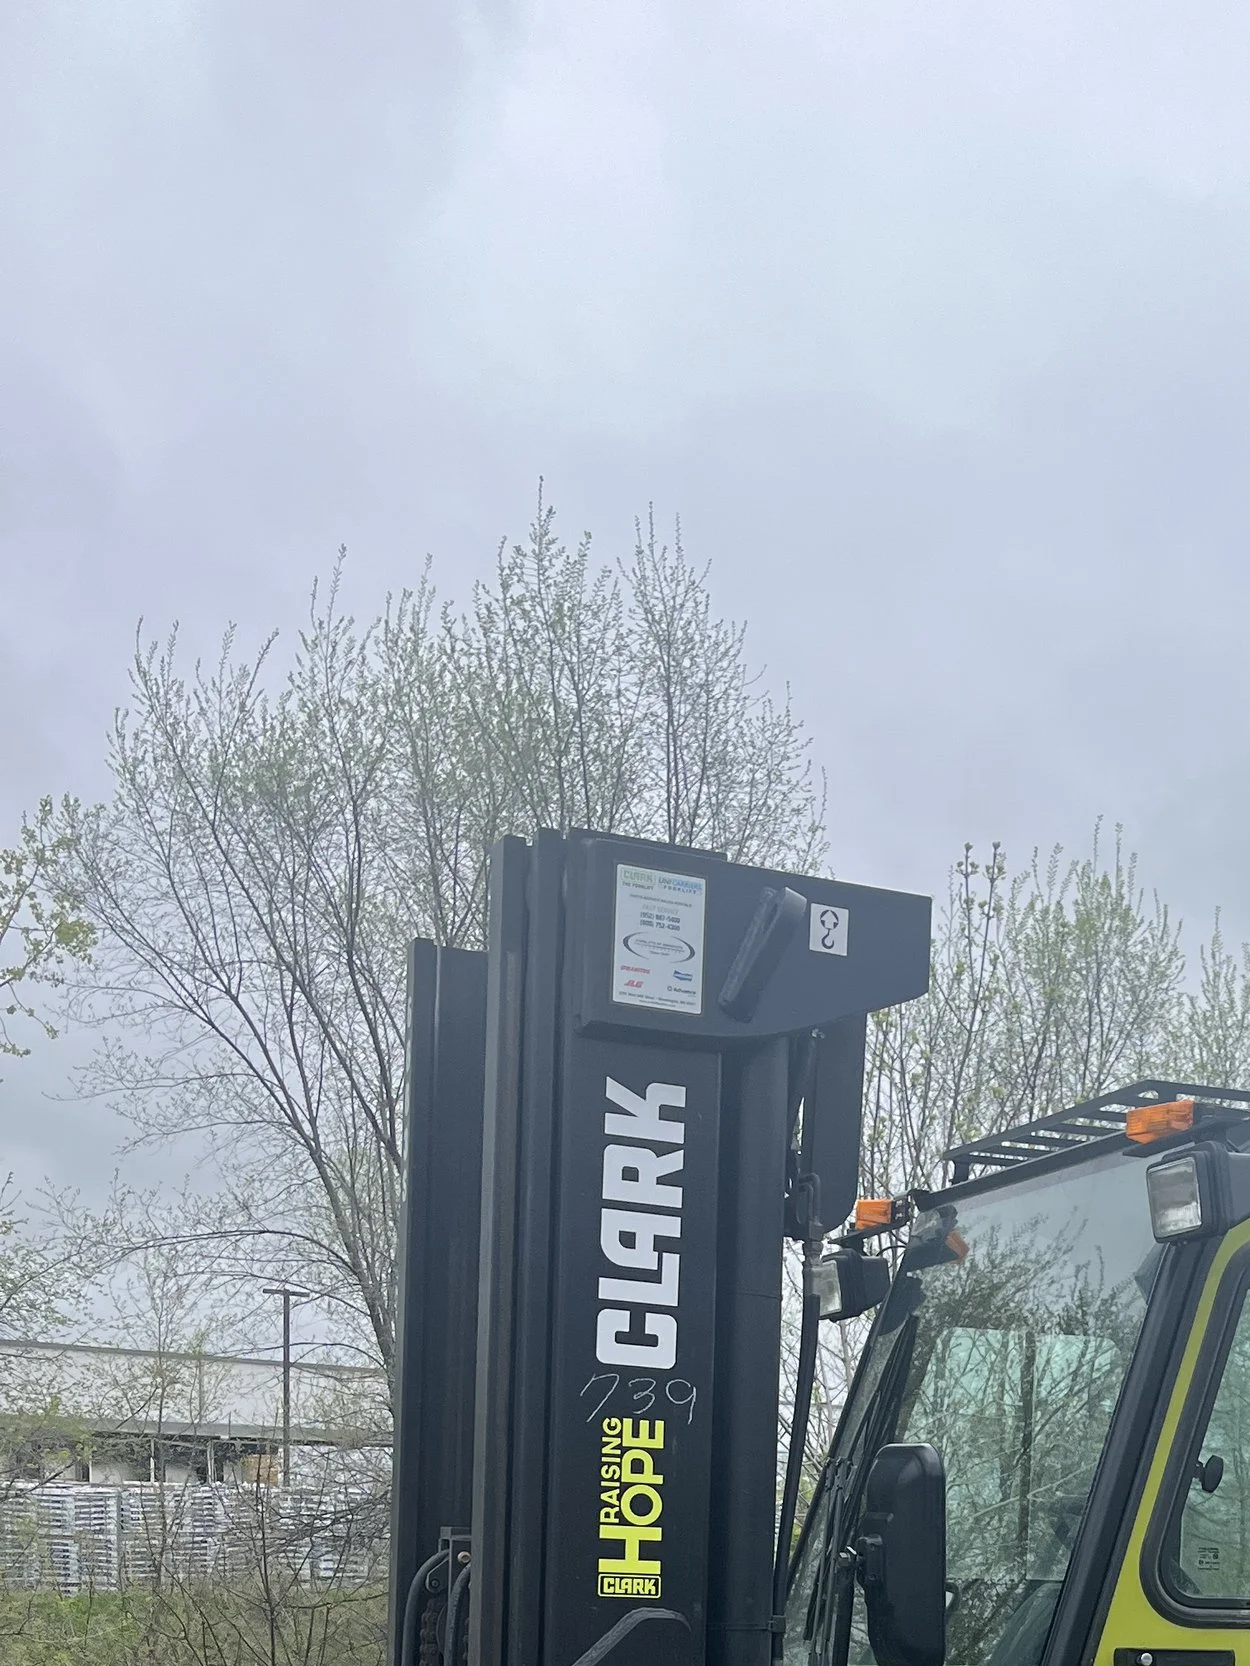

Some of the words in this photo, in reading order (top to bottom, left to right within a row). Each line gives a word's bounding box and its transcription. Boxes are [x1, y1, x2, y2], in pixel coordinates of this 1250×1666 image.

[596, 1076, 687, 1370] CLARK
[580, 1373, 697, 1425] 739
[598, 1418, 665, 1575] HOPE
[599, 1417, 622, 1523] RAISING
[603, 1577, 656, 1595] CLARK
